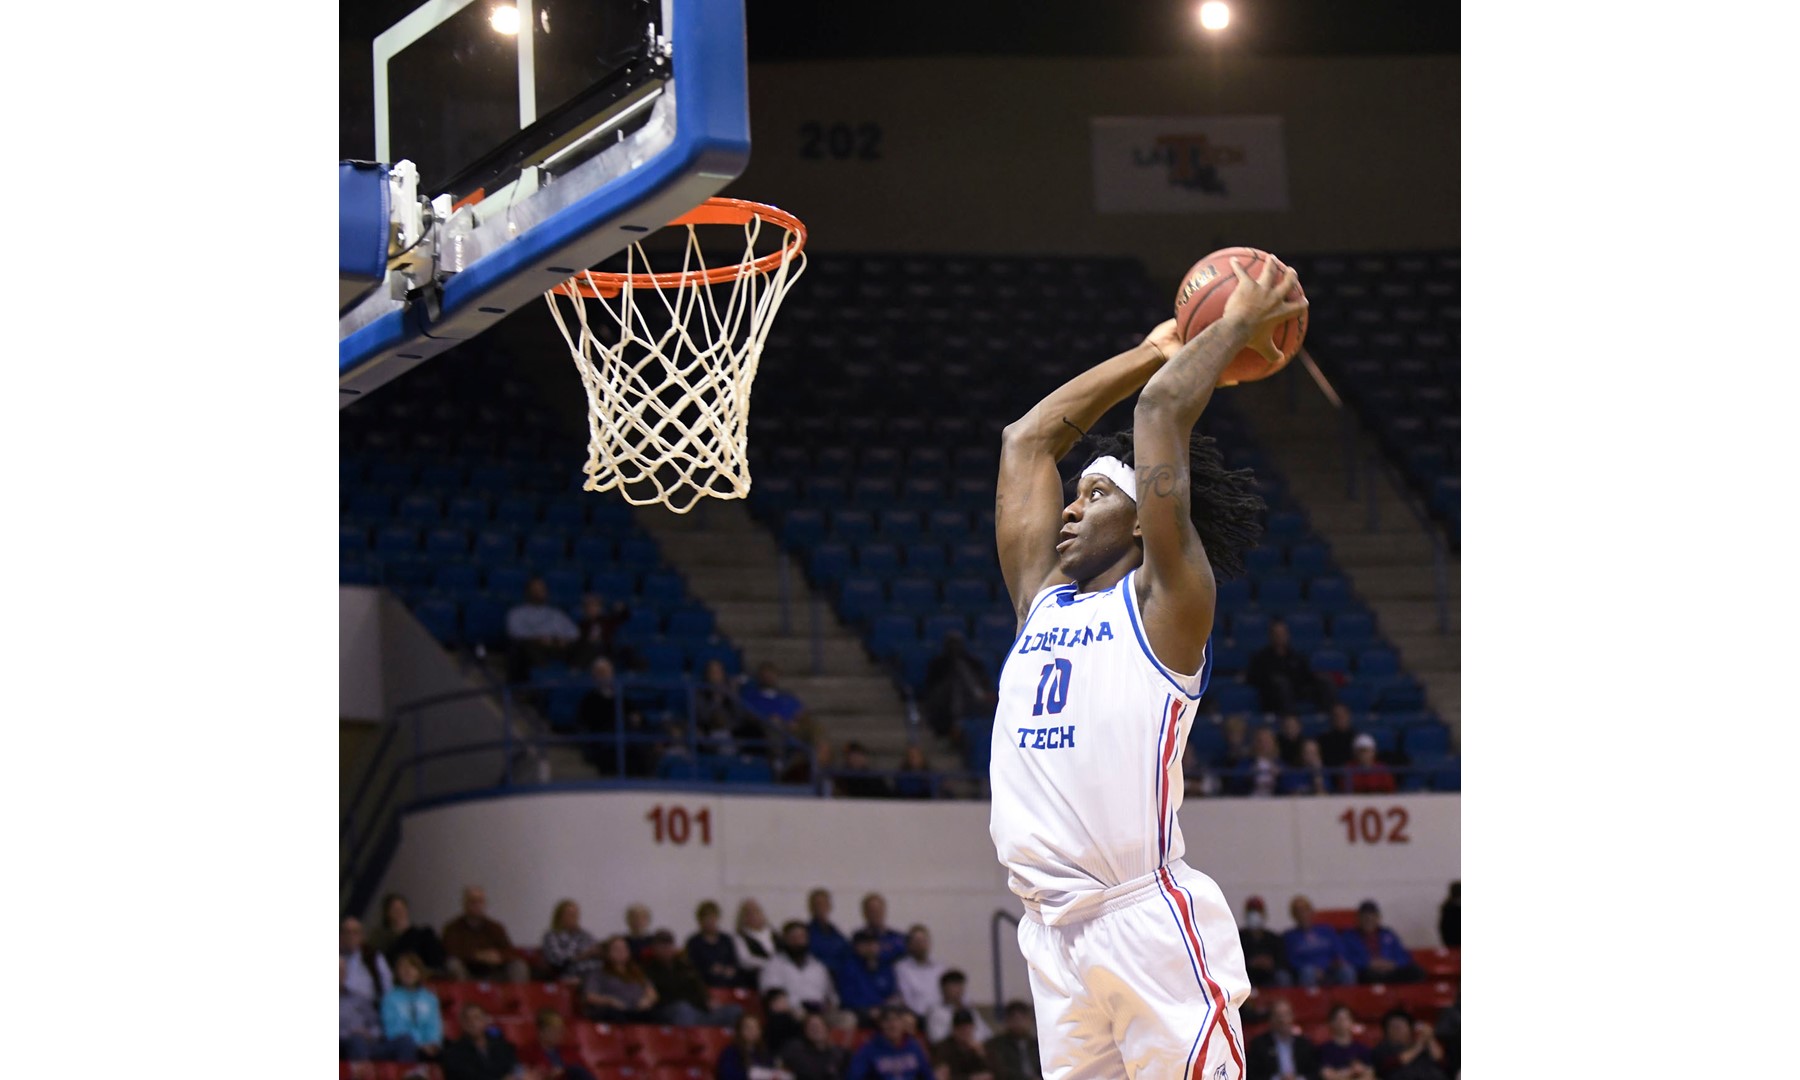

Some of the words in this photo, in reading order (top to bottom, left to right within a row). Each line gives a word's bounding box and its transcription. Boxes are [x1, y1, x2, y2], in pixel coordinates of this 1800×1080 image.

[1018, 621, 1114, 654] LOUSIANA
[1032, 657, 1073, 717] 10
[1017, 725, 1076, 750] TECH
[645, 804, 712, 846] 101
[1340, 806, 1410, 845] 102
